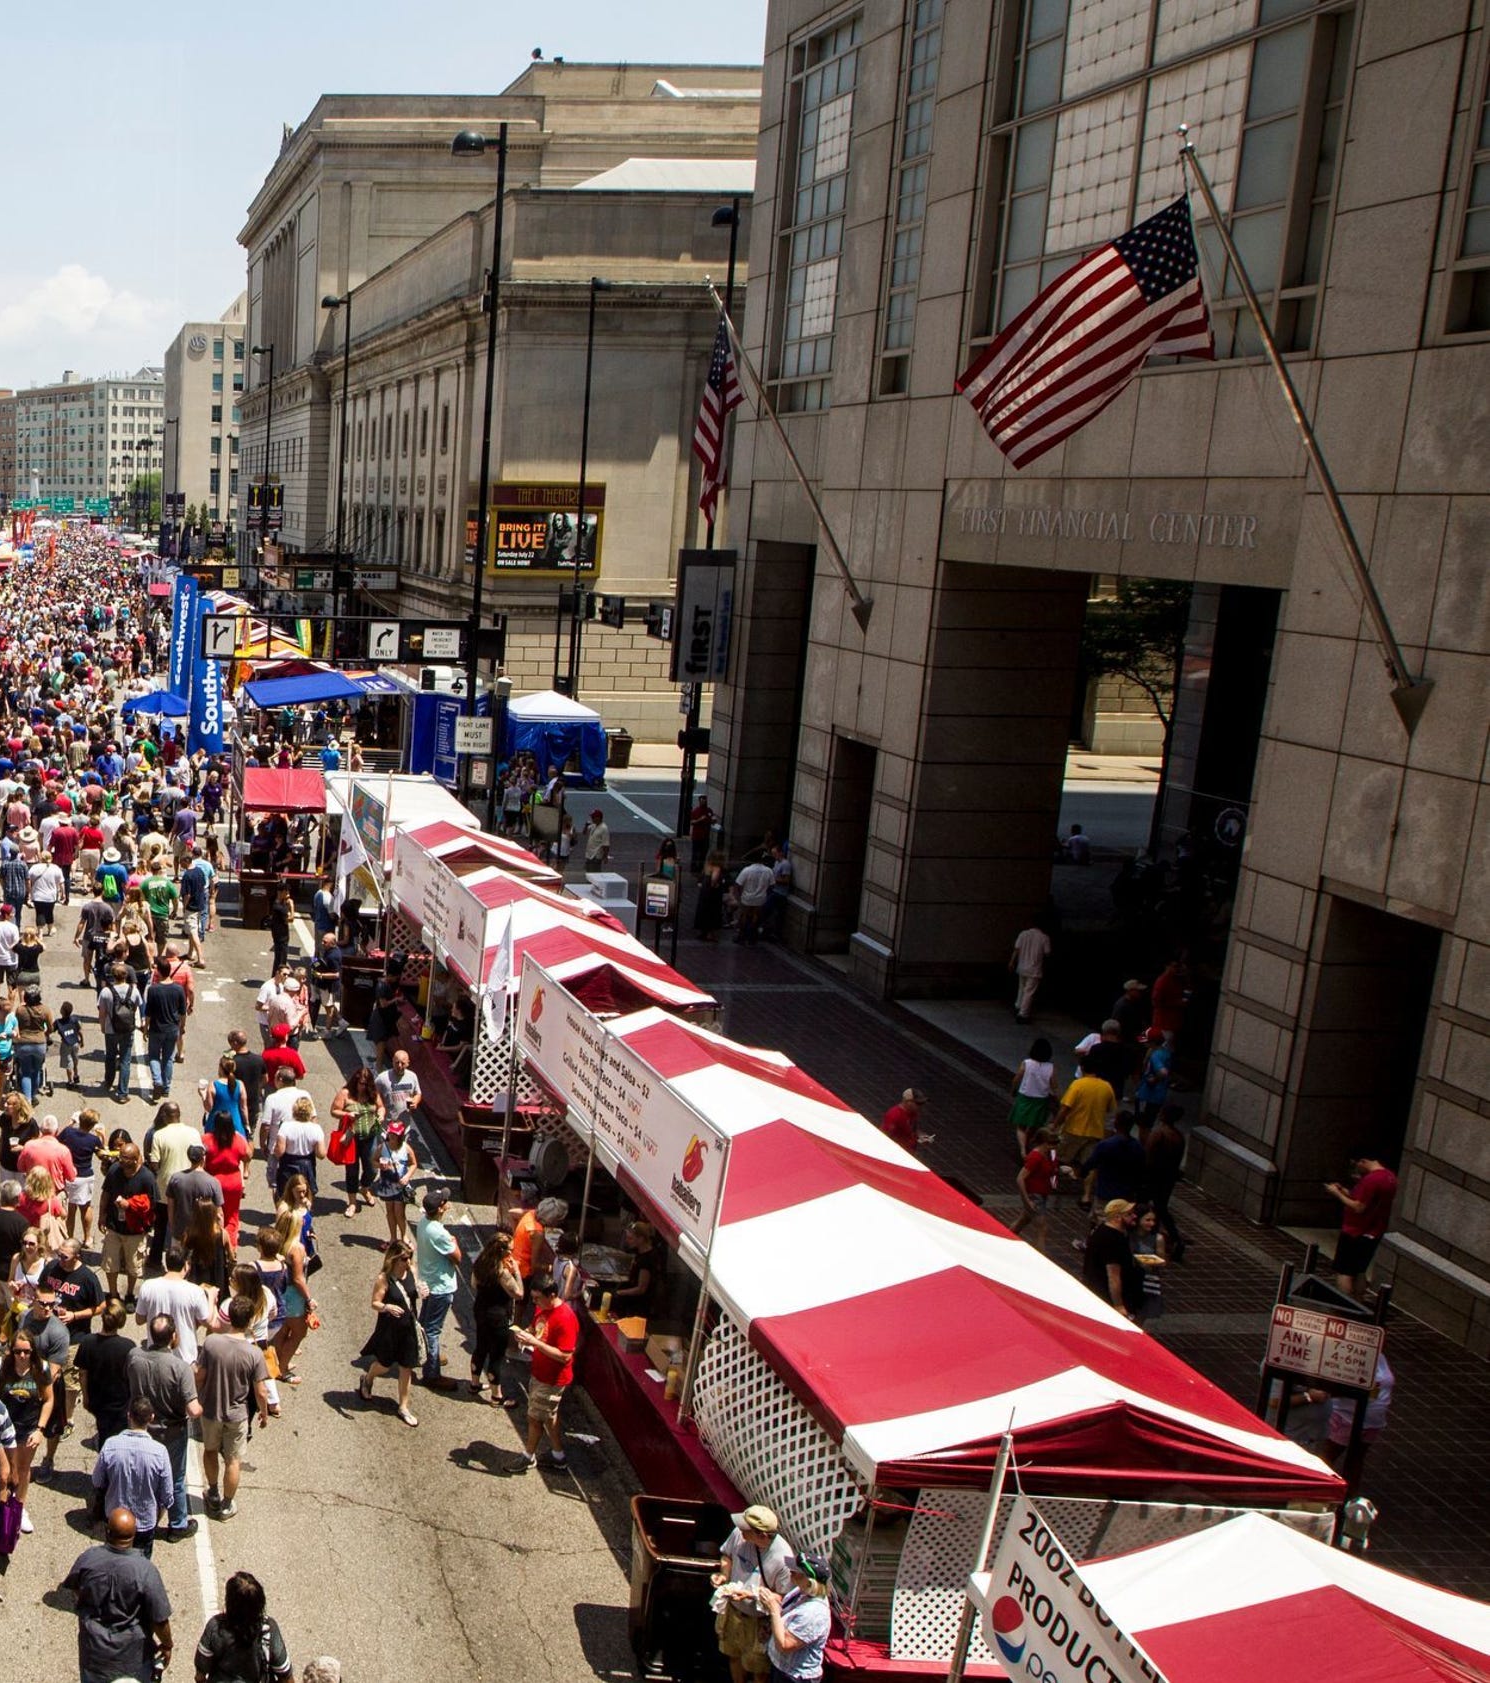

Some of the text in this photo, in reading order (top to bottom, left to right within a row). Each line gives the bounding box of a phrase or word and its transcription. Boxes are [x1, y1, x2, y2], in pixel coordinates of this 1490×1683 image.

[542, 488, 582, 505] THEATR
[499, 523, 547, 532] BRING IT!
[962, 508, 1258, 548] FIRST FINANCIAL CENTER
[498, 532, 545, 549] LIVE
[174, 592, 190, 685] Southwest
[375, 649, 393, 657] ONLY
[200, 654, 217, 735] Southw
[464, 731, 482, 739] MUST
[600, 1069, 612, 1088] Taco
[609, 1054, 621, 1071] and
[621, 1064, 636, 1086] Salsa
[594, 1085, 615, 1114] Chicken
[615, 1105, 628, 1127] Taco
[598, 1112, 611, 1134] Taco
[1276, 1309, 1292, 1323] NO
[1328, 1321, 1344, 1335] NO
[1283, 1331, 1312, 1346] ANY
[1279, 1343, 1312, 1361] TIME
[1333, 1341, 1367, 1357] 7-9AM
[1331, 1352, 1366, 1367] 4-6PM
